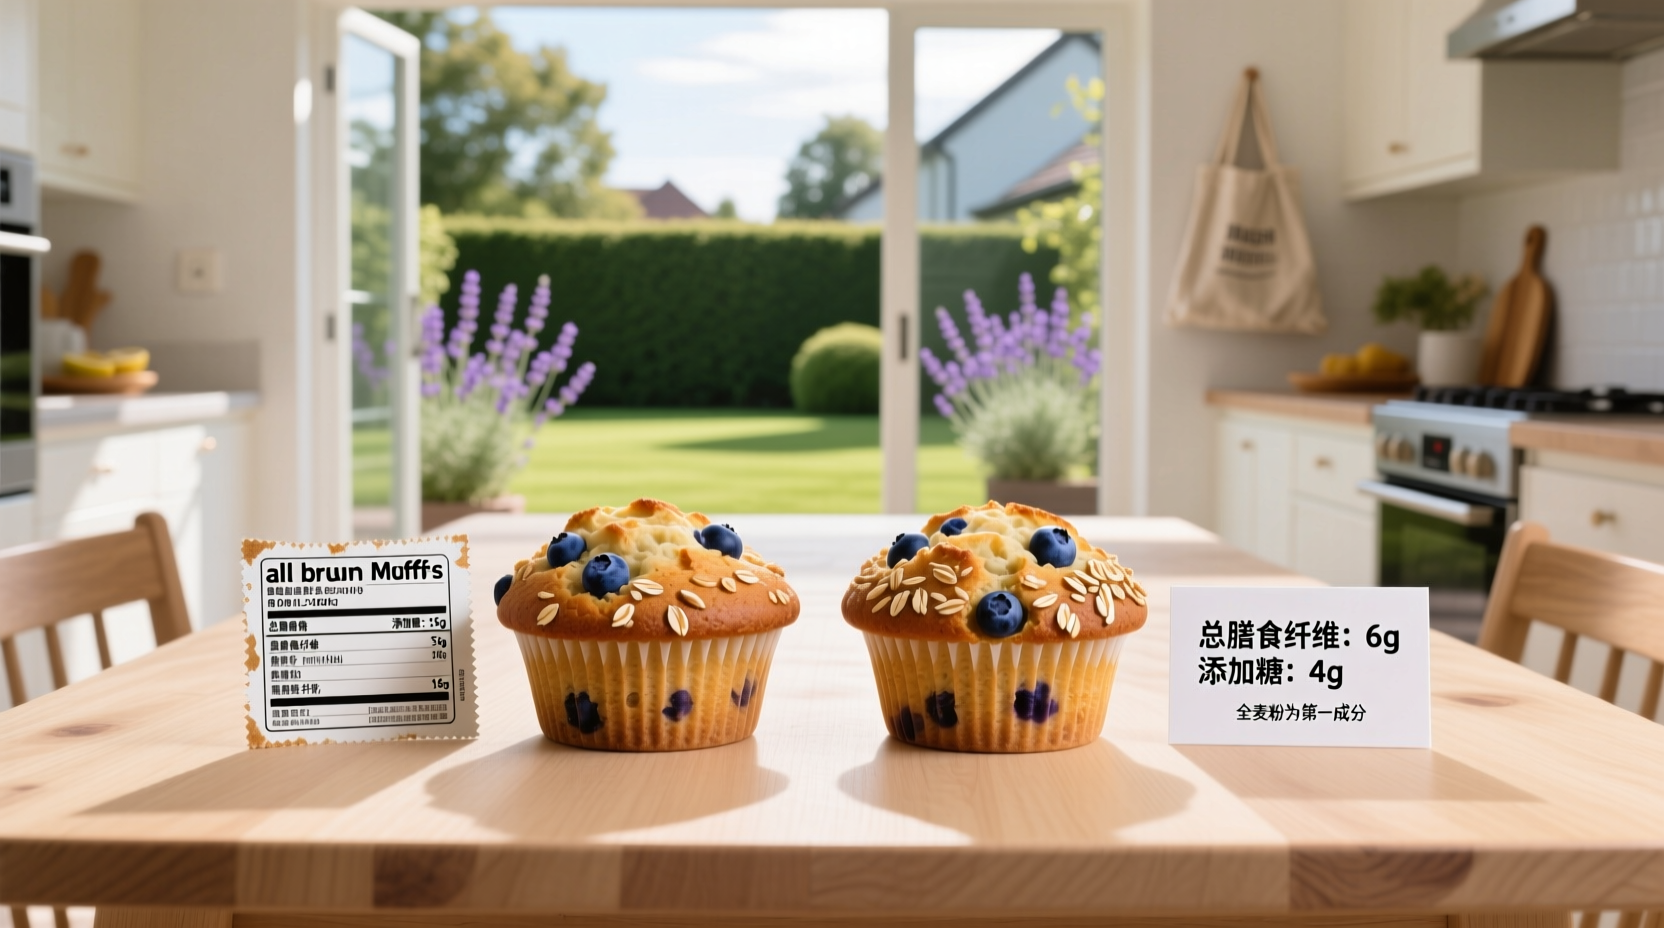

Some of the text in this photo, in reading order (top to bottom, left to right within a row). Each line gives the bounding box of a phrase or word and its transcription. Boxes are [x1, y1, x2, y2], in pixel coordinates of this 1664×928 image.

[265, 562, 293, 583] all
[1236, 702, 1367, 722] 全麦粉为第一成分
